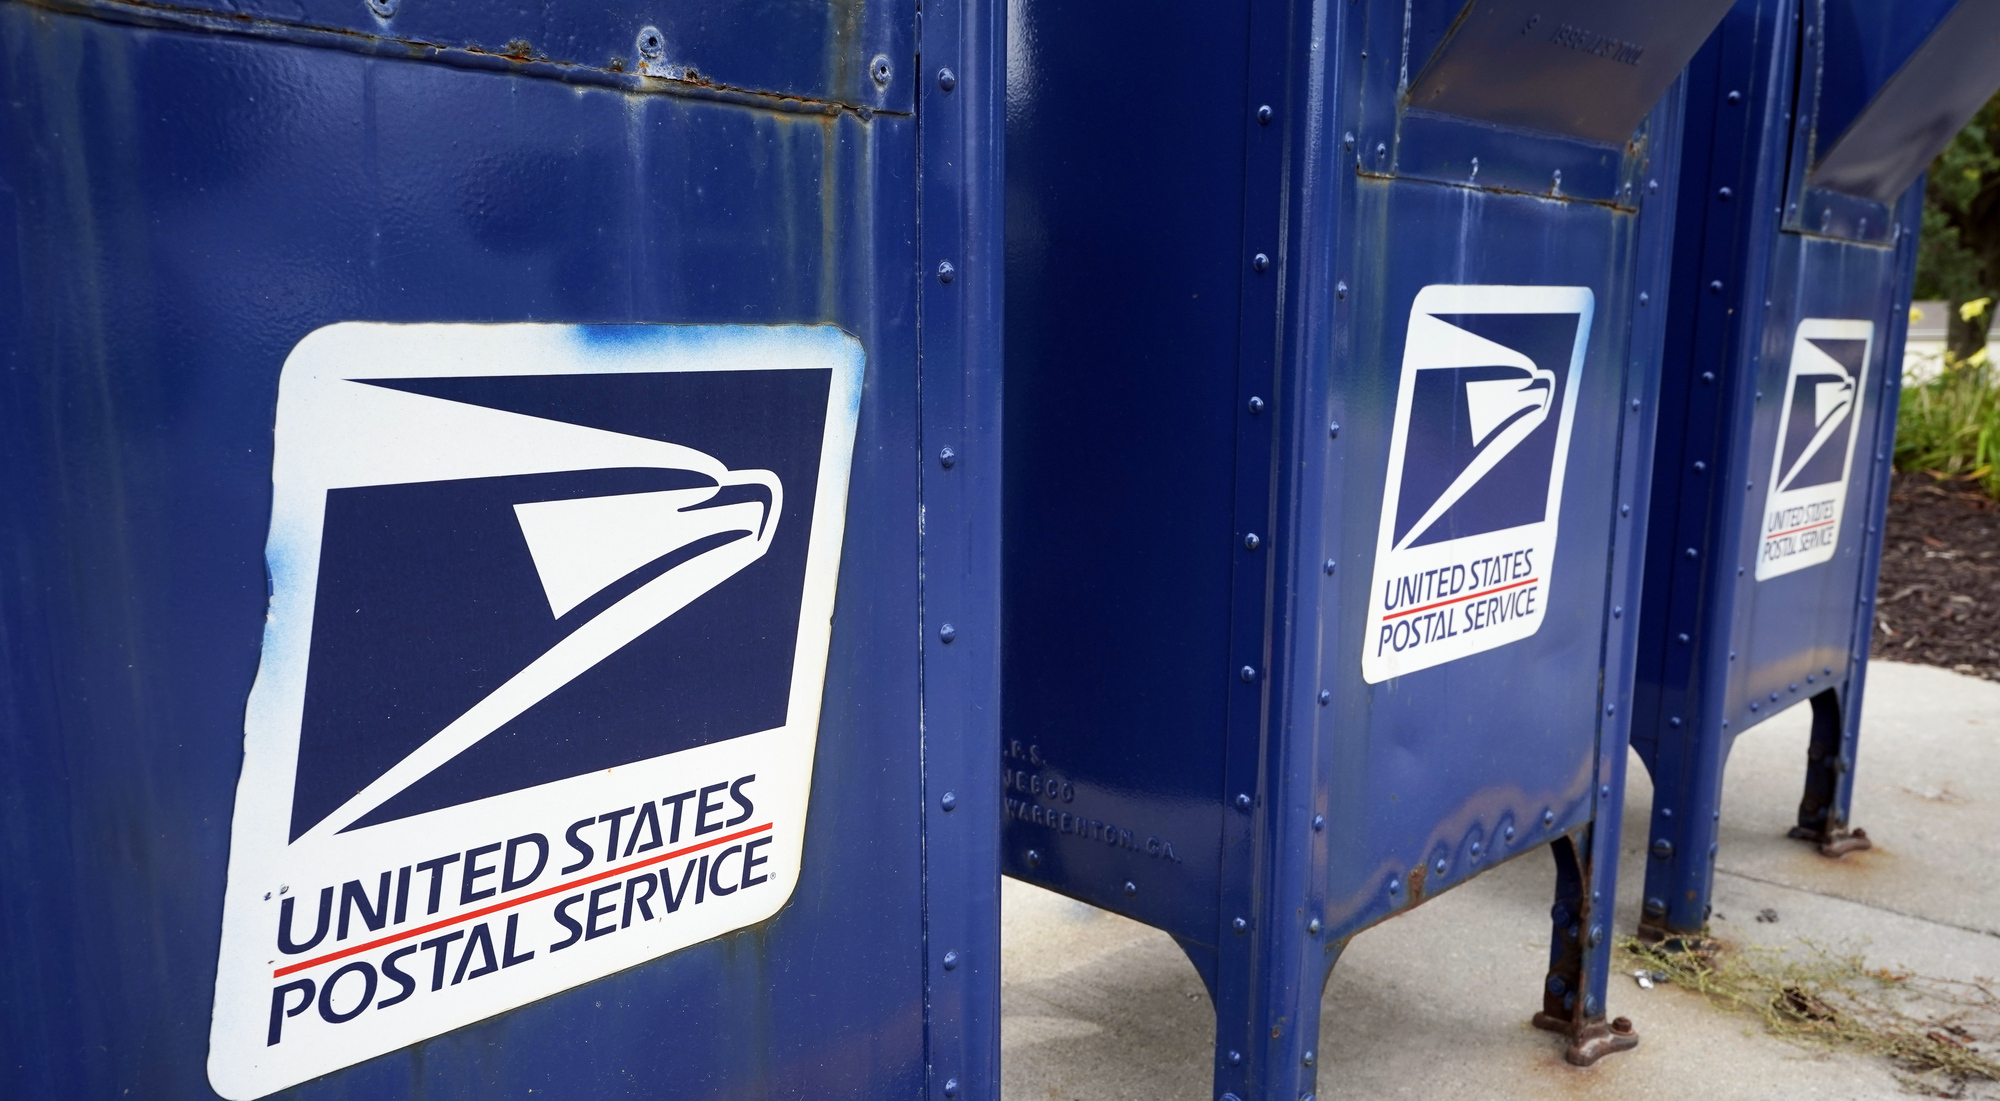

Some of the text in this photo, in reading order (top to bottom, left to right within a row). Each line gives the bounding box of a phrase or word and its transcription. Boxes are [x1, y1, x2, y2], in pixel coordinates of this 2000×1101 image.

[1762, 526, 1835, 564] POSTAL SERVICE
[1768, 499, 1836, 533] UNITED STATES
[1384, 547, 1534, 611] UNITED STATES
[1377, 586, 1538, 658] POSTAL SERVICE
[276, 773, 756, 955] UNITED STATES
[266, 835, 773, 1048] POSTAL SERVICE
